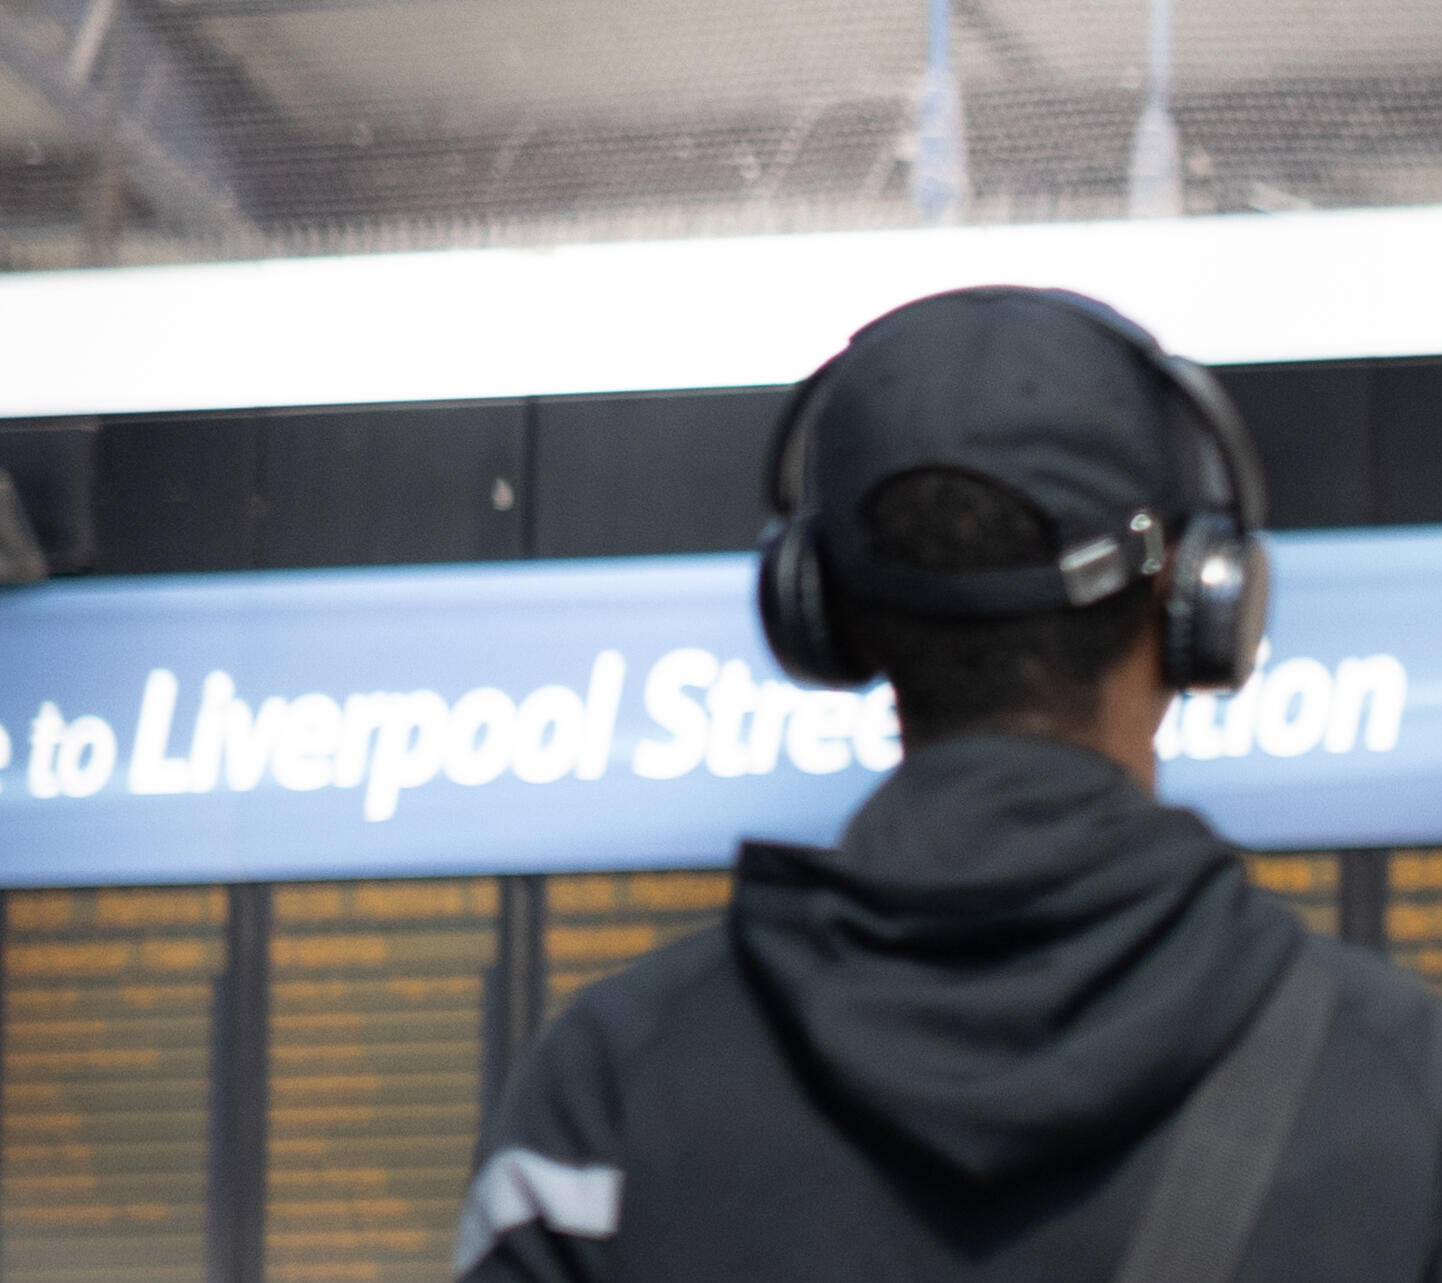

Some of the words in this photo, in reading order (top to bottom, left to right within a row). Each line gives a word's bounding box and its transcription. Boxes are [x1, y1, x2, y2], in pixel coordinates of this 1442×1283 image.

[28, 702, 117, 799] to
[128, 650, 627, 822] Liverpool
[632, 649, 905, 780] Stree
